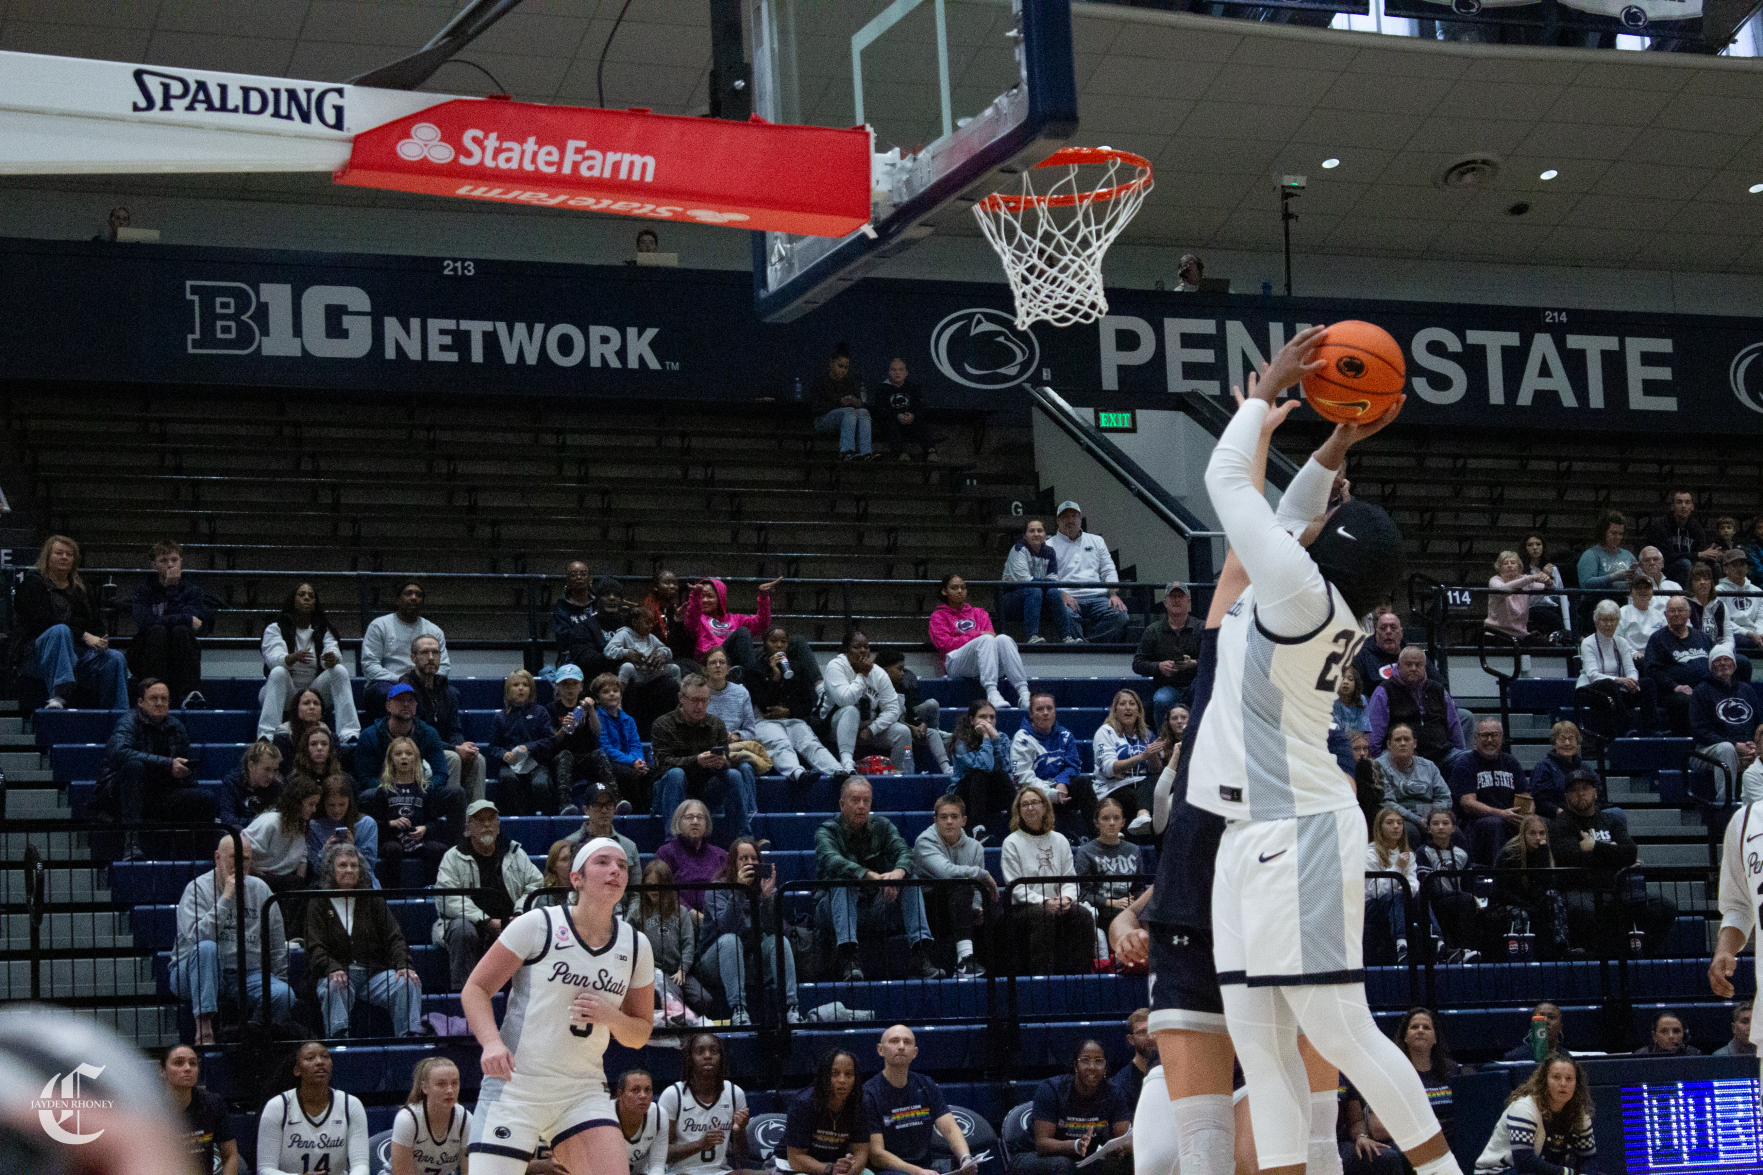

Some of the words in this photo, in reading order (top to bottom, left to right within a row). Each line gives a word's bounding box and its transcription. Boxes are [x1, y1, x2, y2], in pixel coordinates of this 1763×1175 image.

[132, 68, 345, 132] SPALDING
[443, 259, 475, 276] 213
[1545, 310, 1567, 324] 214
[383, 316, 663, 371] NETWORK
[1411, 327, 1679, 412] STATE
[1099, 411, 1131, 428] EXIT
[1011, 501, 1024, 517] G
[1447, 591, 1472, 605] 114
[547, 961, 590, 988] Penn
[592, 968, 627, 997] State
[1536, 1028, 1546, 1039] G
[682, 1117, 708, 1132] Penn
[288, 1133, 316, 1149] Penn
[316, 1133, 345, 1149] State
